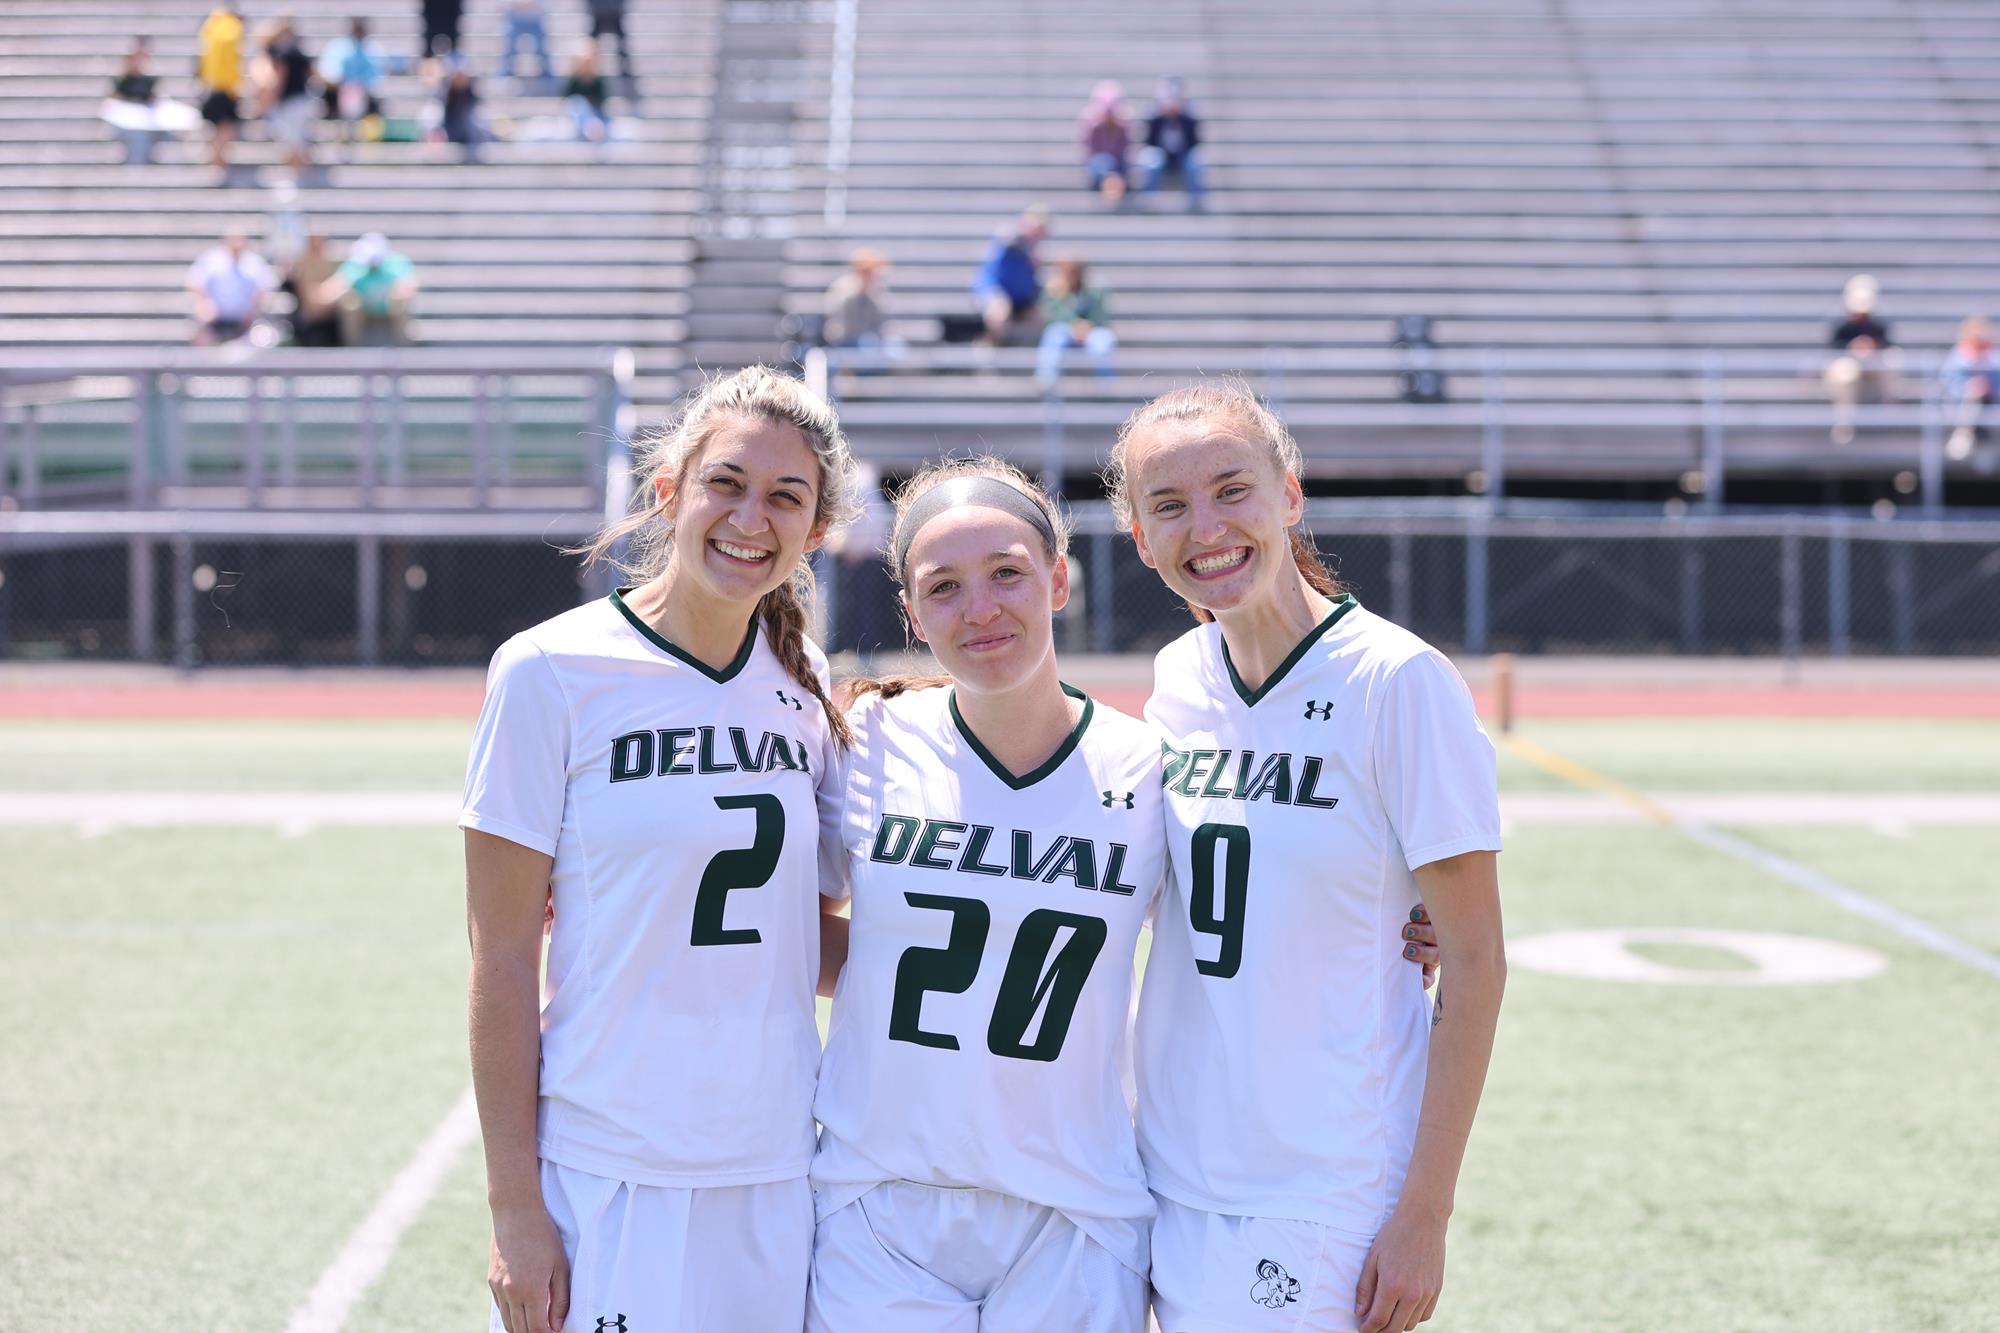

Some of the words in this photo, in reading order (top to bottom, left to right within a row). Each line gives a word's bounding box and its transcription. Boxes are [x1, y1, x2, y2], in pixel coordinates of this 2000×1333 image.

[690, 793, 785, 946] 2
[870, 813, 1137, 896] DELVAL
[1190, 822, 1251, 979] 9
[889, 891, 1107, 1062] 20
